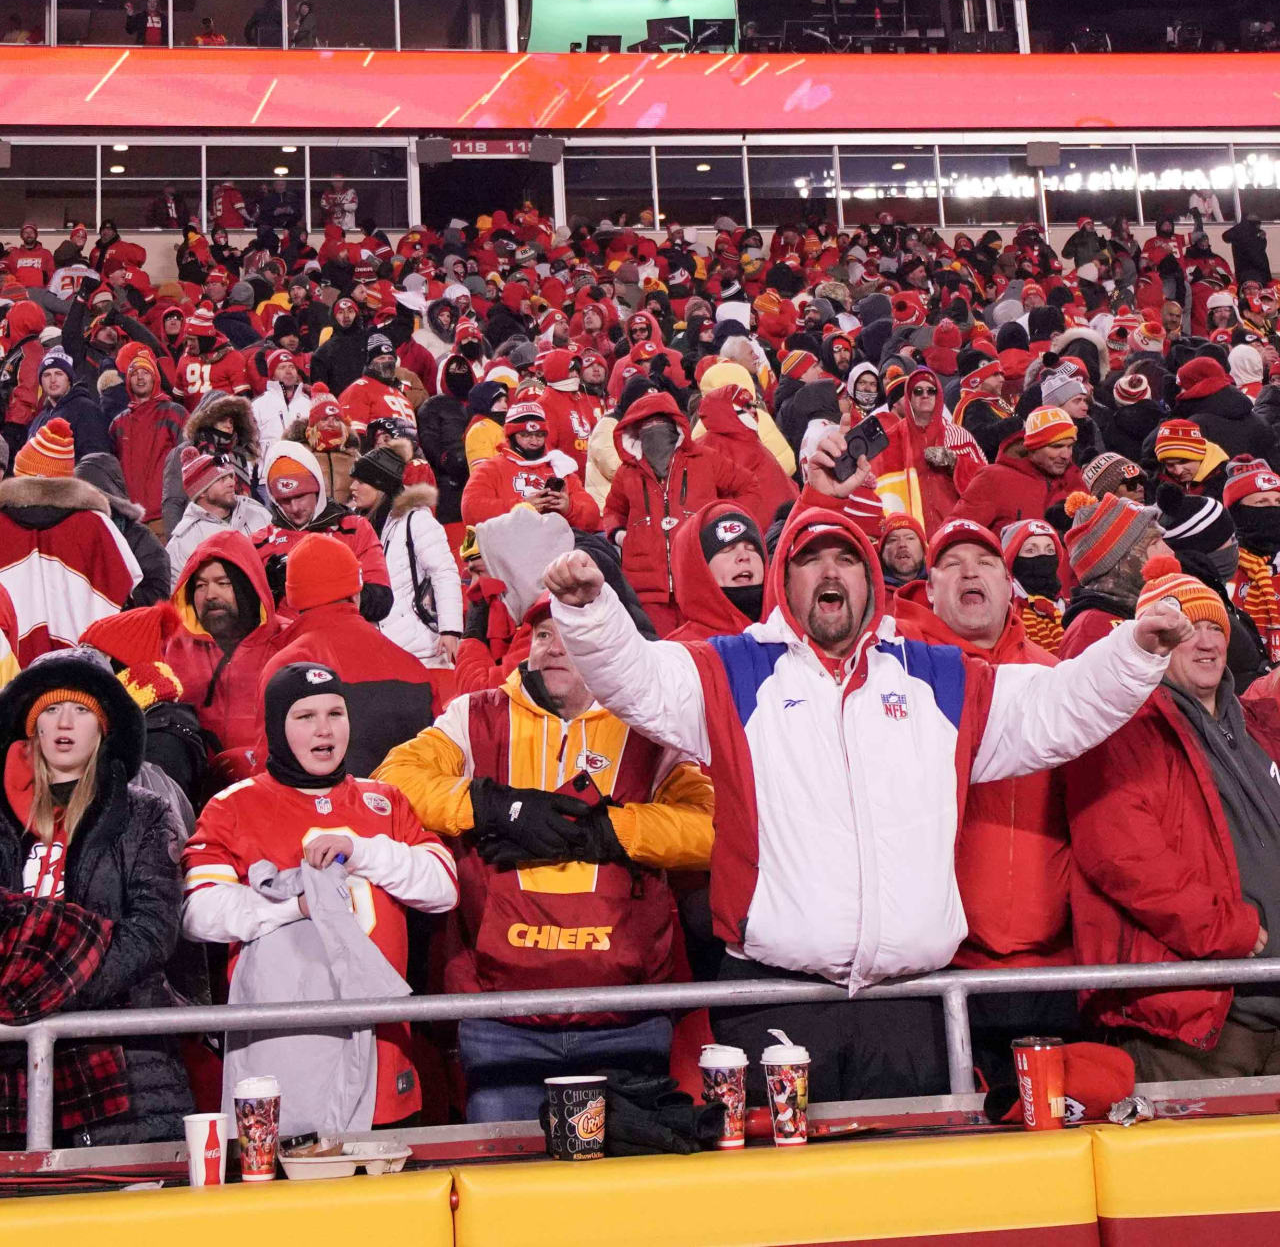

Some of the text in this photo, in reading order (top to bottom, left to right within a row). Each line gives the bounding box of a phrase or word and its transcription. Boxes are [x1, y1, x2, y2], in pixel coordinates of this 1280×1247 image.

[453, 142, 487, 152] 118
[186, 362, 212, 394] 91
[507, 923, 612, 951] CHIEFS
[1019, 1073, 1036, 1126] Coca-Cola
